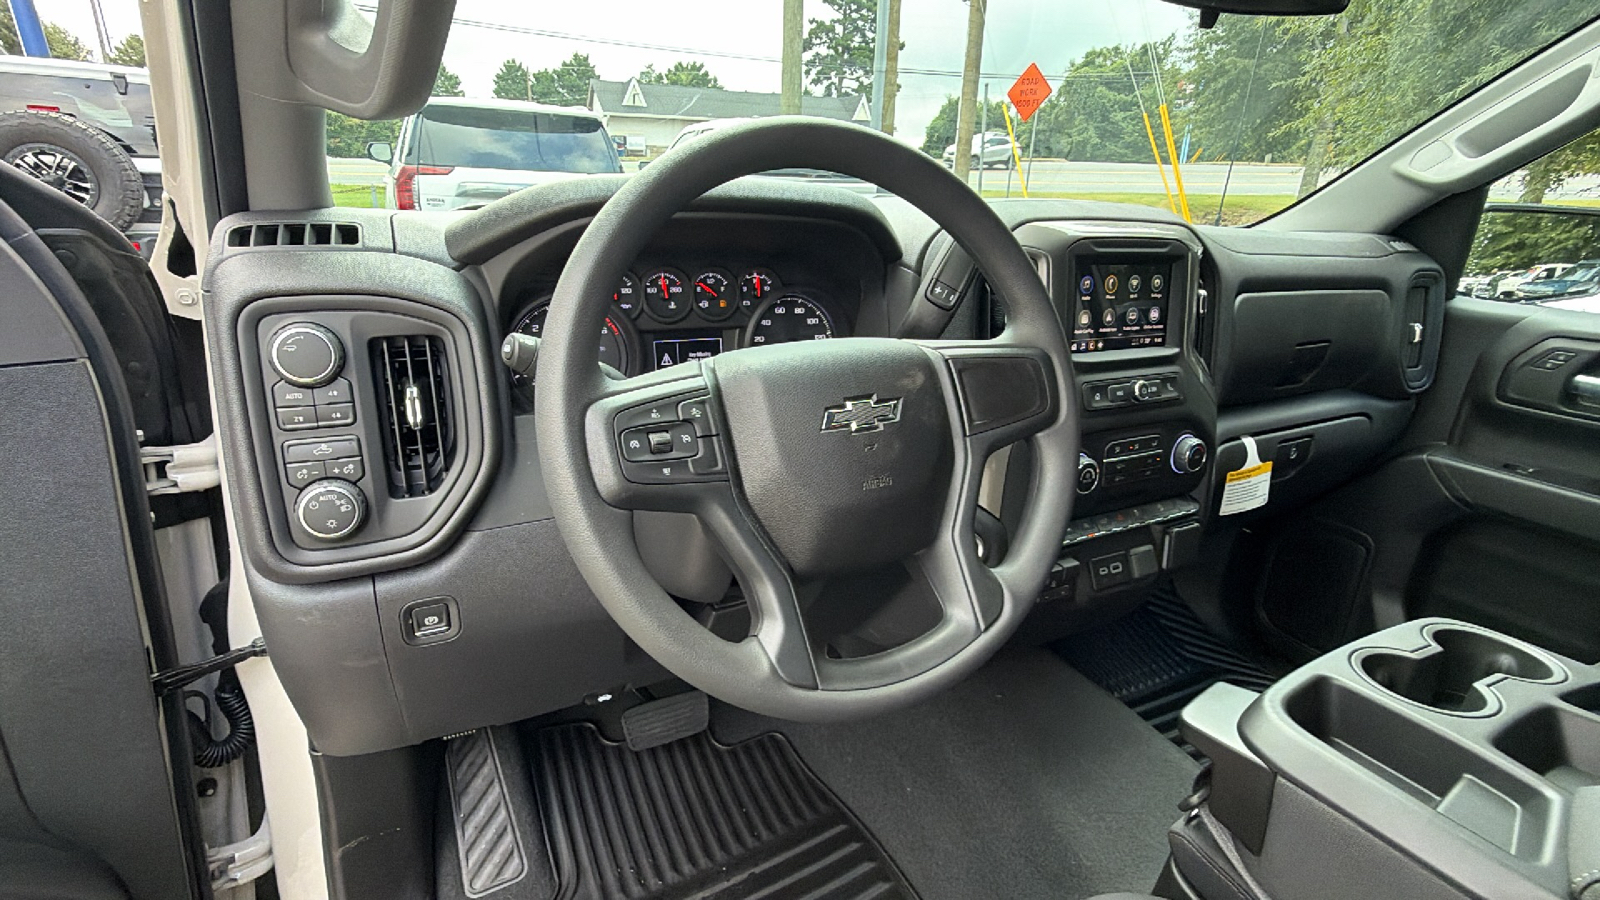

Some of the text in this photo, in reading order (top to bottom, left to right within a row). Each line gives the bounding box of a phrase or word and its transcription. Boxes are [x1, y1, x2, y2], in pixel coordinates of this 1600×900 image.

[1021, 78, 1040, 86] ROAD
[1020, 88, 1038, 97] WORK
[1032, 98, 1040, 107] FT
[774, 306, 786, 314] 60
[806, 317, 819, 325] 100
[532, 324, 539, 332] 2
[285, 392, 303, 400] AUTO
